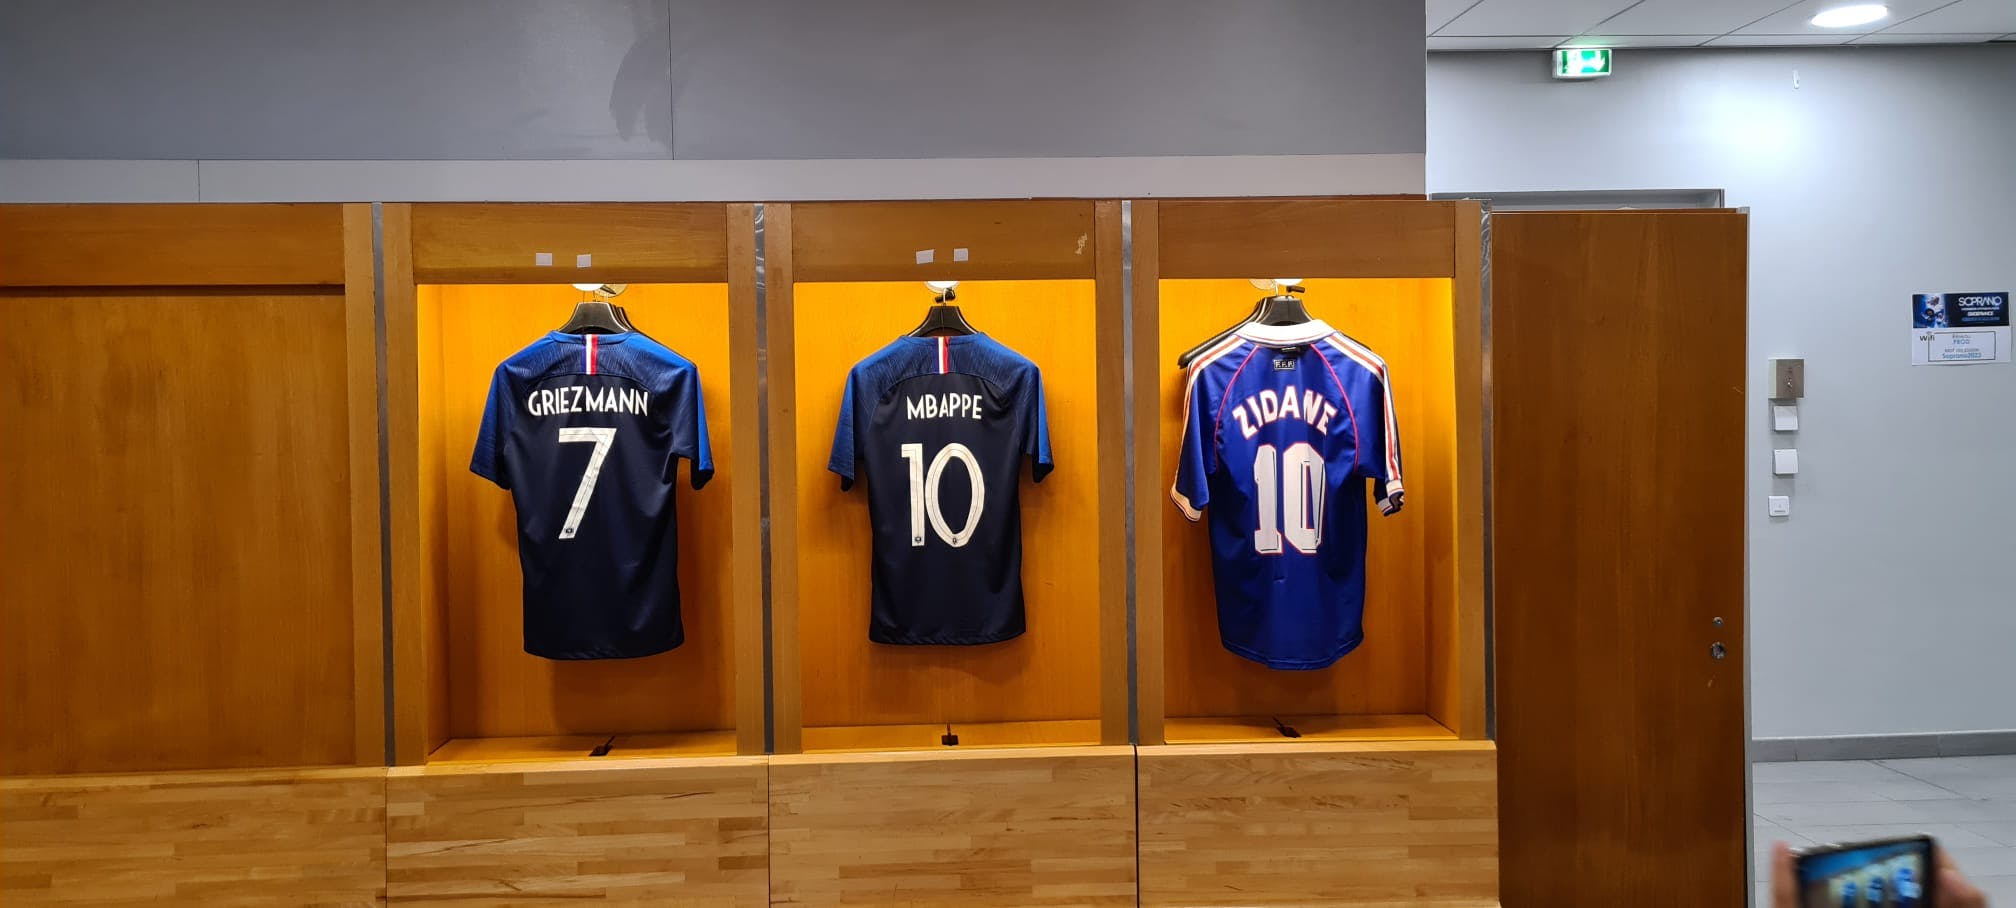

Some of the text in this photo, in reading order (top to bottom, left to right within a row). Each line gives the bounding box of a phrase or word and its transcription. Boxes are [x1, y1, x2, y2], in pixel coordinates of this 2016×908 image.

[1958, 296, 2002, 306] SOPRANO
[528, 385, 648, 416] GRIEZMANN
[906, 393, 983, 420] MBAPPE
[1232, 385, 1338, 440] ZIDANE
[558, 427, 617, 539] 7
[901, 442, 985, 548] 10
[1254, 442, 1326, 554] 10
